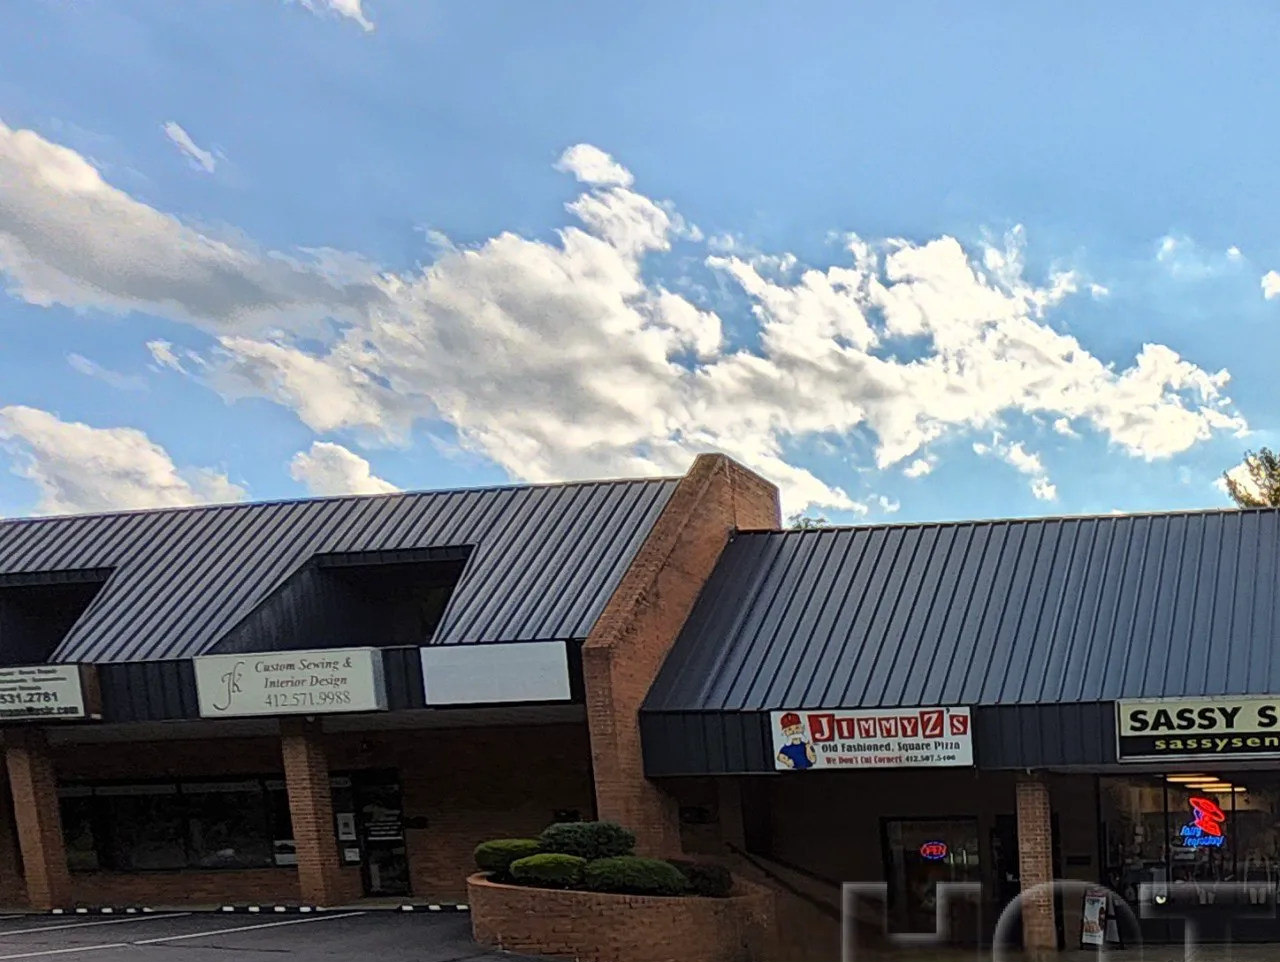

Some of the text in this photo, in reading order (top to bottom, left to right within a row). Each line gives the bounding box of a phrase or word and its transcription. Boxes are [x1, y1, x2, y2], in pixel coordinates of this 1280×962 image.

[254, 657, 353, 673] Custom Sewing &
[264, 674, 347, 688] Interior Design
[264, 690, 351, 707] 412.571.9988
[1129, 706, 1242, 733] SASSY
[821, 743, 838, 753] Old
[897, 741, 931, 753] Square
[934, 740, 960, 750] Pizza
[825, 755, 837, 765] We
[838, 754, 859, 765] Don't
[860, 754, 872, 764] Cut
